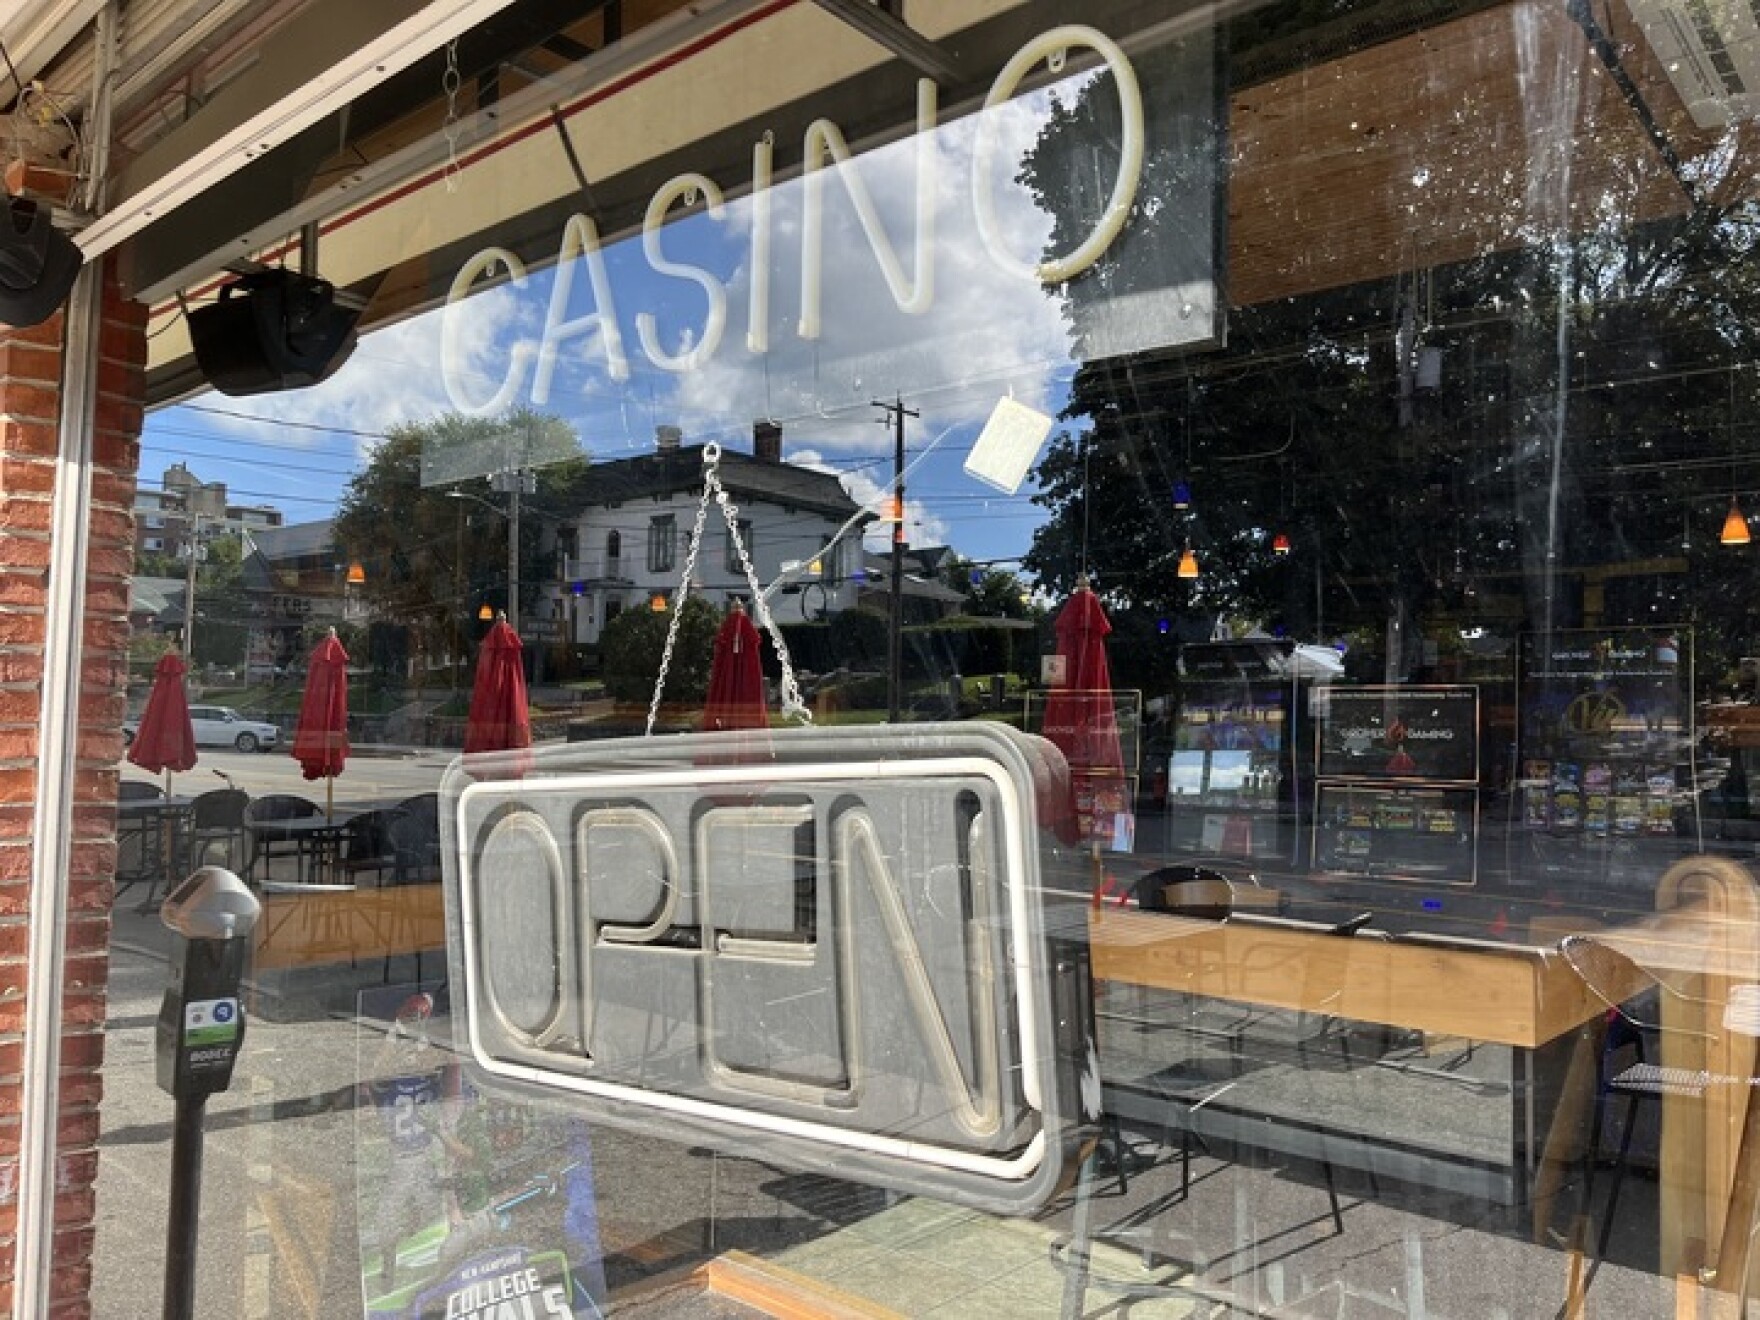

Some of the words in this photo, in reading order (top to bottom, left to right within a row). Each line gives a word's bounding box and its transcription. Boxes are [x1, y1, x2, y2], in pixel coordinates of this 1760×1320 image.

[440, 24, 1144, 416] CASINO
[480, 797, 1001, 1137] OPEN
[446, 1267, 541, 1318] COLLEGE
